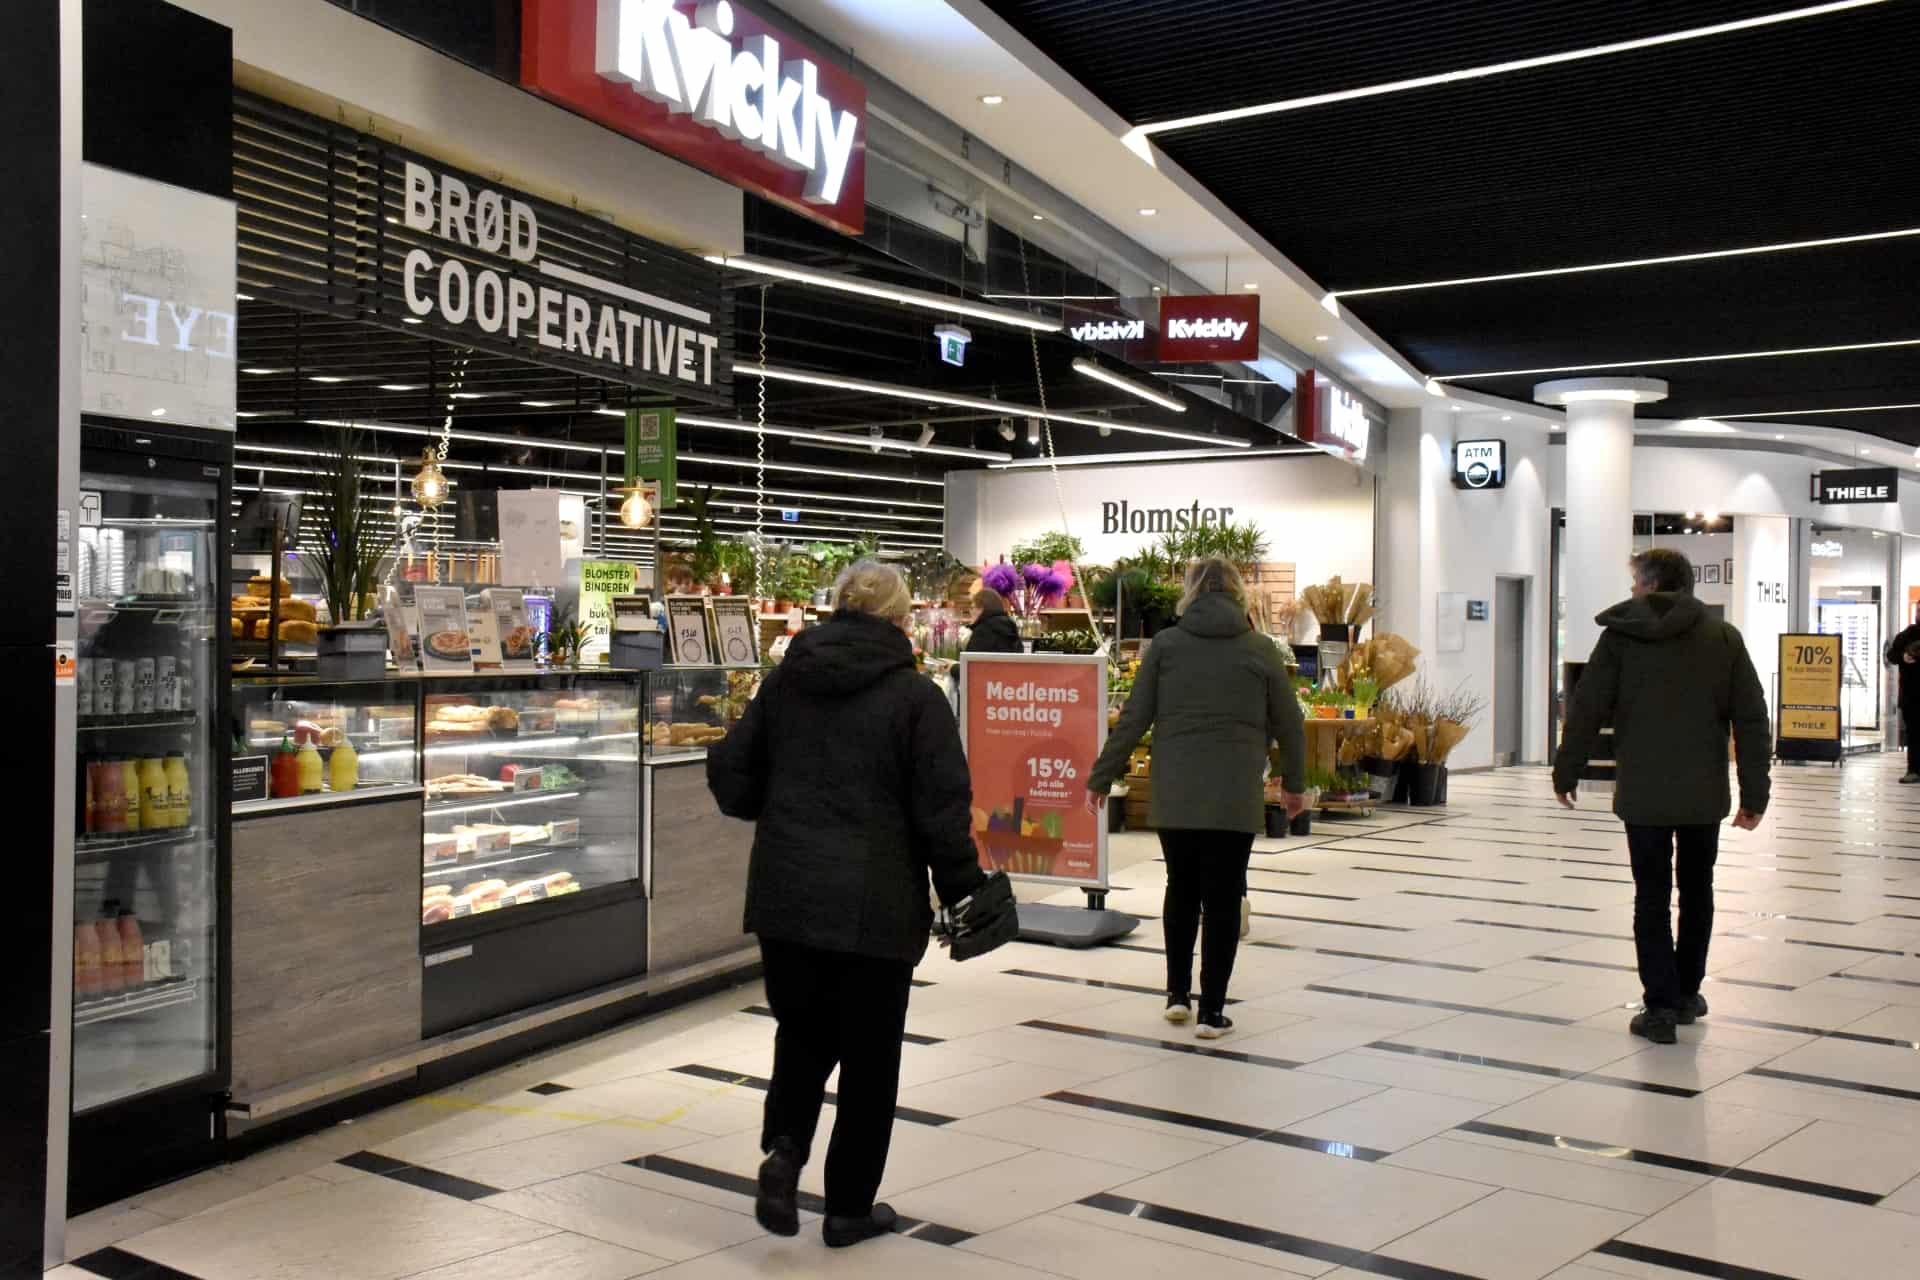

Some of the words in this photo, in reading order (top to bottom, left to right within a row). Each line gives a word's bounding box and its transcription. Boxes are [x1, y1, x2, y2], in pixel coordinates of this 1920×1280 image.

[615, 0, 858, 205] Kvickly
[404, 161, 538, 262] BRØD
[403, 249, 719, 386] COOPERATIVET
[1167, 317, 1249, 342] Kvickly
[1465, 447, 1493, 458] ATM
[1826, 486, 1889, 500] THIELE
[1101, 498, 1235, 536] Blomster
[585, 568, 631, 580] BLOMSTER
[585, 581, 630, 593] BINDEREN
[985, 680, 1079, 704] Medlems
[985, 701, 1062, 729] søndag
[1026, 757, 1077, 779] 15%
